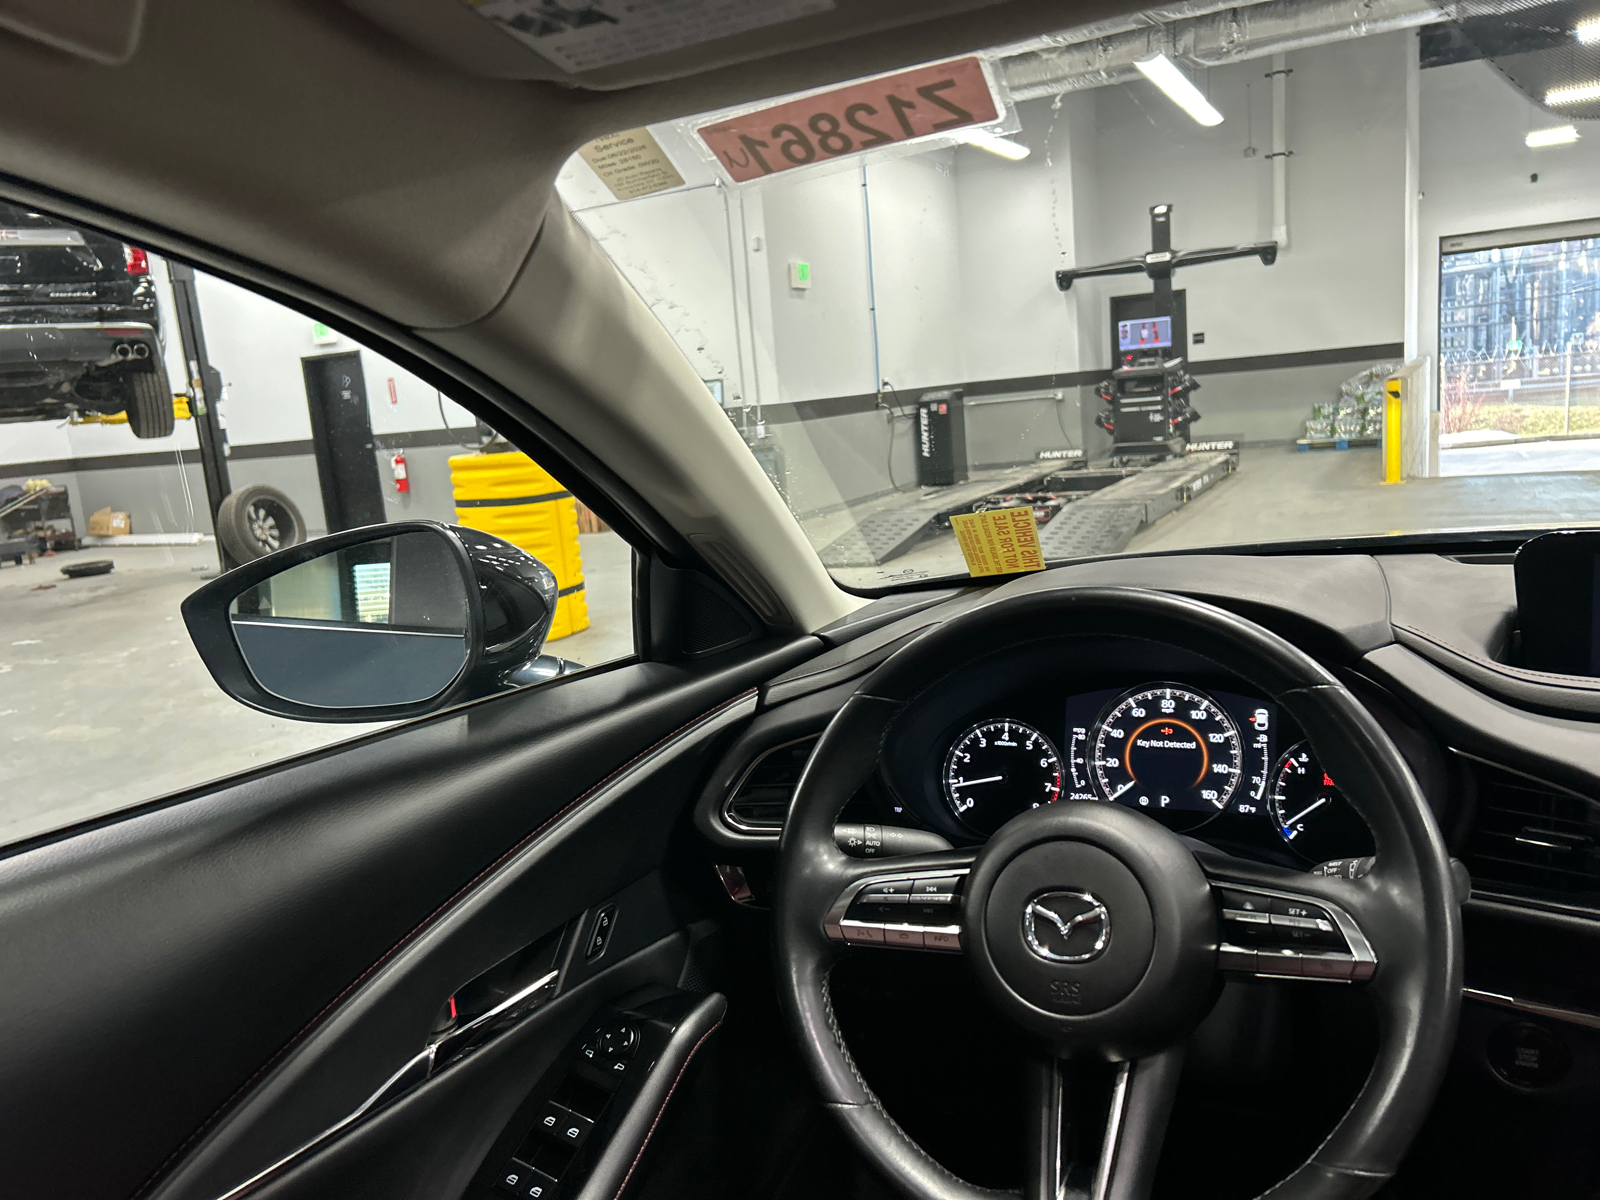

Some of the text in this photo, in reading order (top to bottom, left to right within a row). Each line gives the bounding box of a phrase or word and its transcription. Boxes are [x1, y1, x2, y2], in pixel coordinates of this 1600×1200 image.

[594, 137, 635, 153] Service
[920, 407, 930, 457] HUNTER
[1185, 441, 1233, 451] HUNTER
[1039, 450, 1082, 459] HUNTER
[1161, 699, 1175, 708] 80
[1132, 708, 1146, 718] 60
[1190, 710, 1207, 720] 100
[1002, 732, 1009, 741] 4
[1110, 729, 1124, 739] 40
[1209, 734, 1224, 743] 120
[979, 738, 986, 747] 3
[1026, 740, 1033, 750] 5
[1137, 740, 1196, 749] Key Not Detected
[963, 753, 971, 763] 2
[1105, 758, 1119, 767] 20
[1040, 758, 1048, 768] 6
[1212, 764, 1229, 774] 140
[1251, 776, 1261, 784] 70
[1044, 783, 1052, 792] 7
[1202, 790, 1218, 799] 160
[966, 798, 974, 807] 0
[1161, 795, 1170, 807] P
[1296, 823, 1304, 831] C
[1050, 981, 1080, 997] SRS
